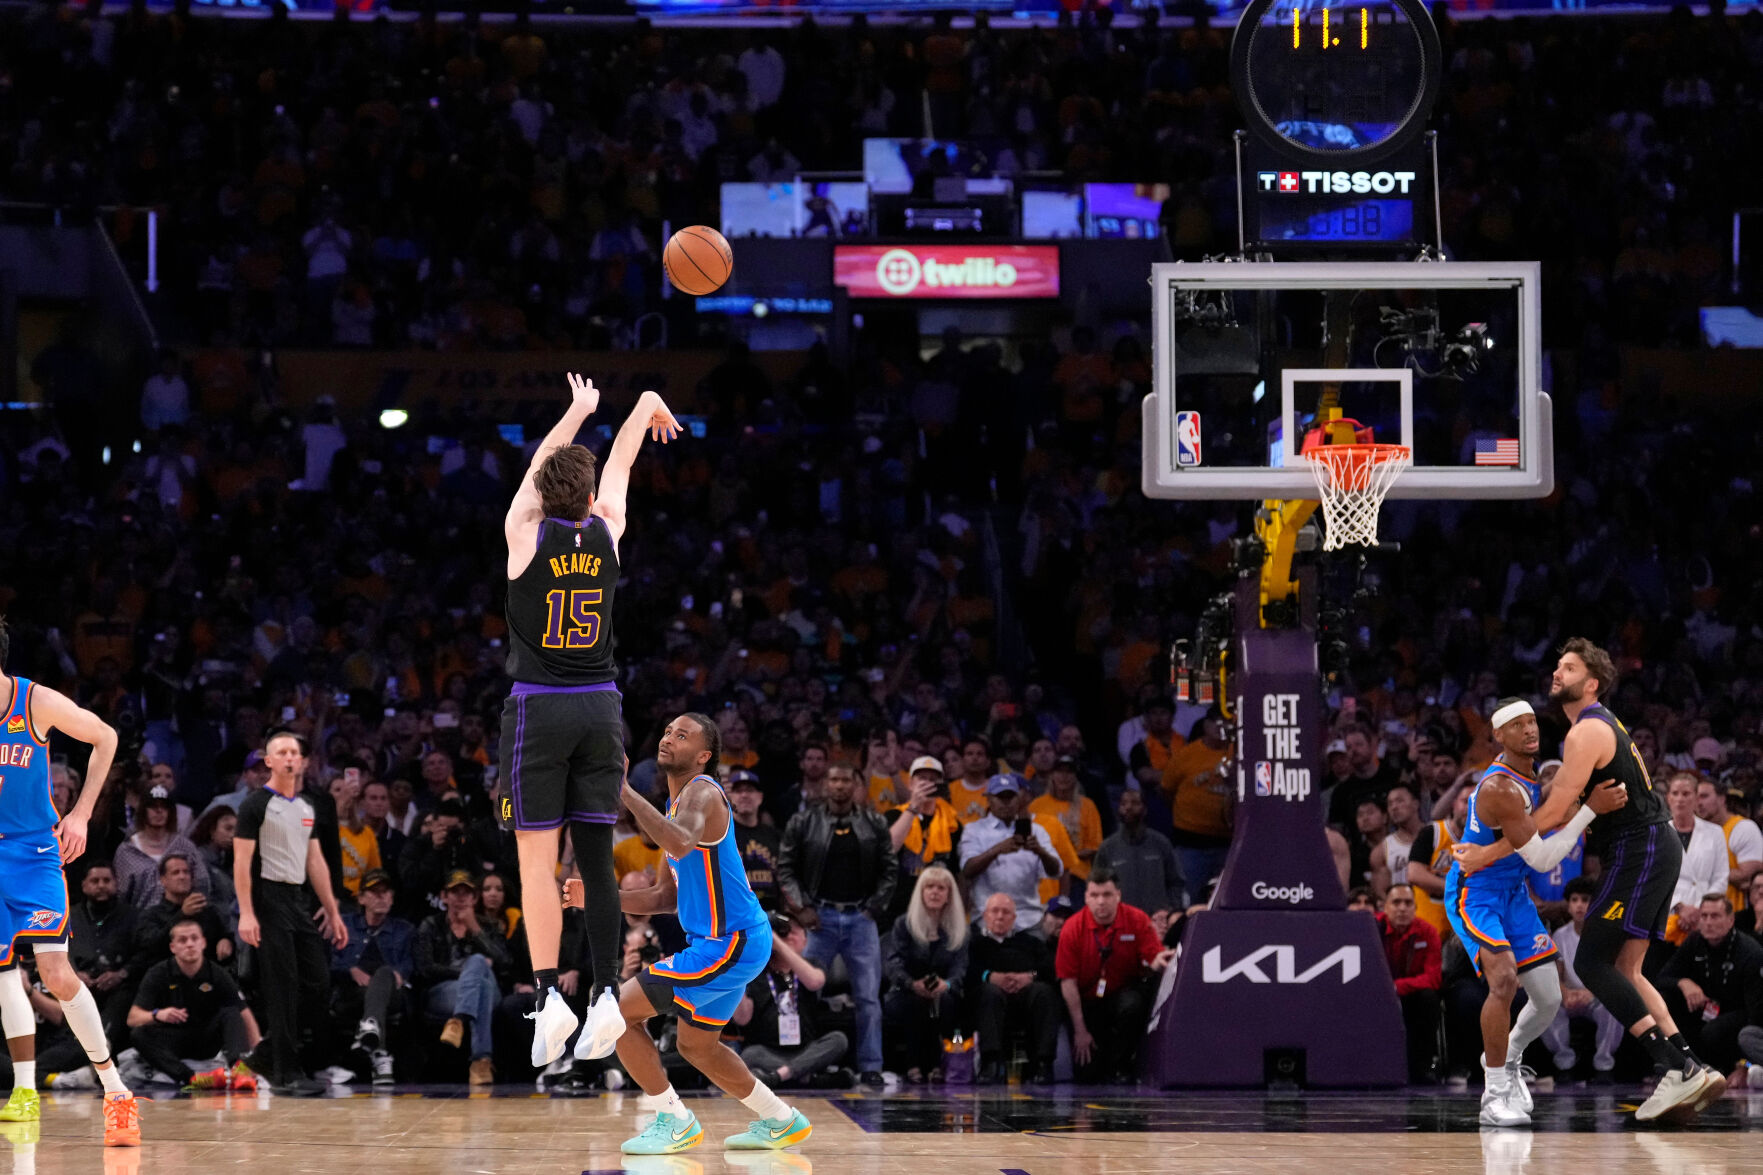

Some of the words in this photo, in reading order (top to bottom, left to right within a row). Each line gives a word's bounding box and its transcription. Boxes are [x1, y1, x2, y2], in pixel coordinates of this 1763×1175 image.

[1293, 8, 1367, 49] 11.1
[1301, 171, 1416, 193] TISSOT
[924, 257, 1017, 287] twilio
[549, 553, 602, 577] REAVES
[542, 589, 603, 648] 15
[1263, 694, 1300, 726] GET
[1263, 727, 1301, 760] THE
[1272, 761, 1311, 802] App
[1251, 881, 1315, 904] Google
[1202, 944, 1361, 984] KIA
